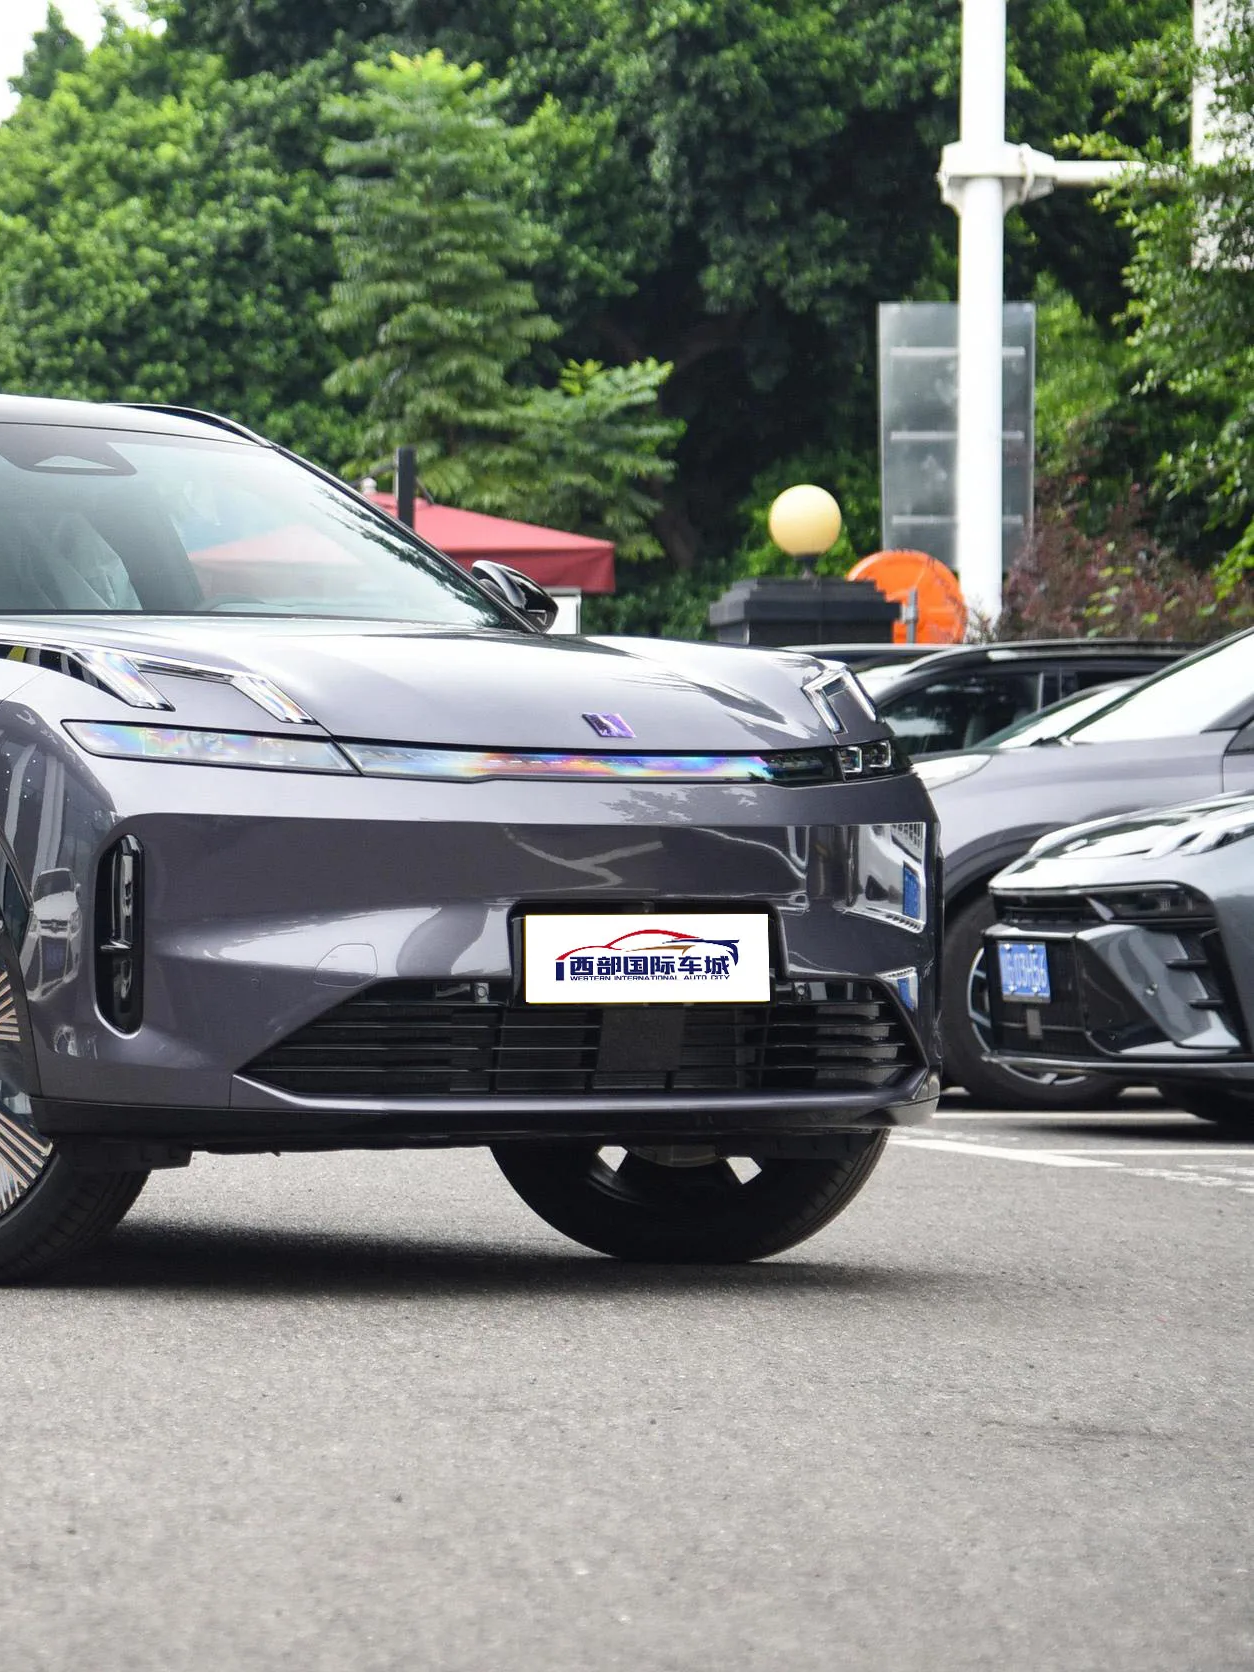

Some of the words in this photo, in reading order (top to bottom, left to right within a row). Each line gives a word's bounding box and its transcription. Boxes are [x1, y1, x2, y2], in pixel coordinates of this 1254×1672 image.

[569, 955, 730, 975] 西部国际车城
